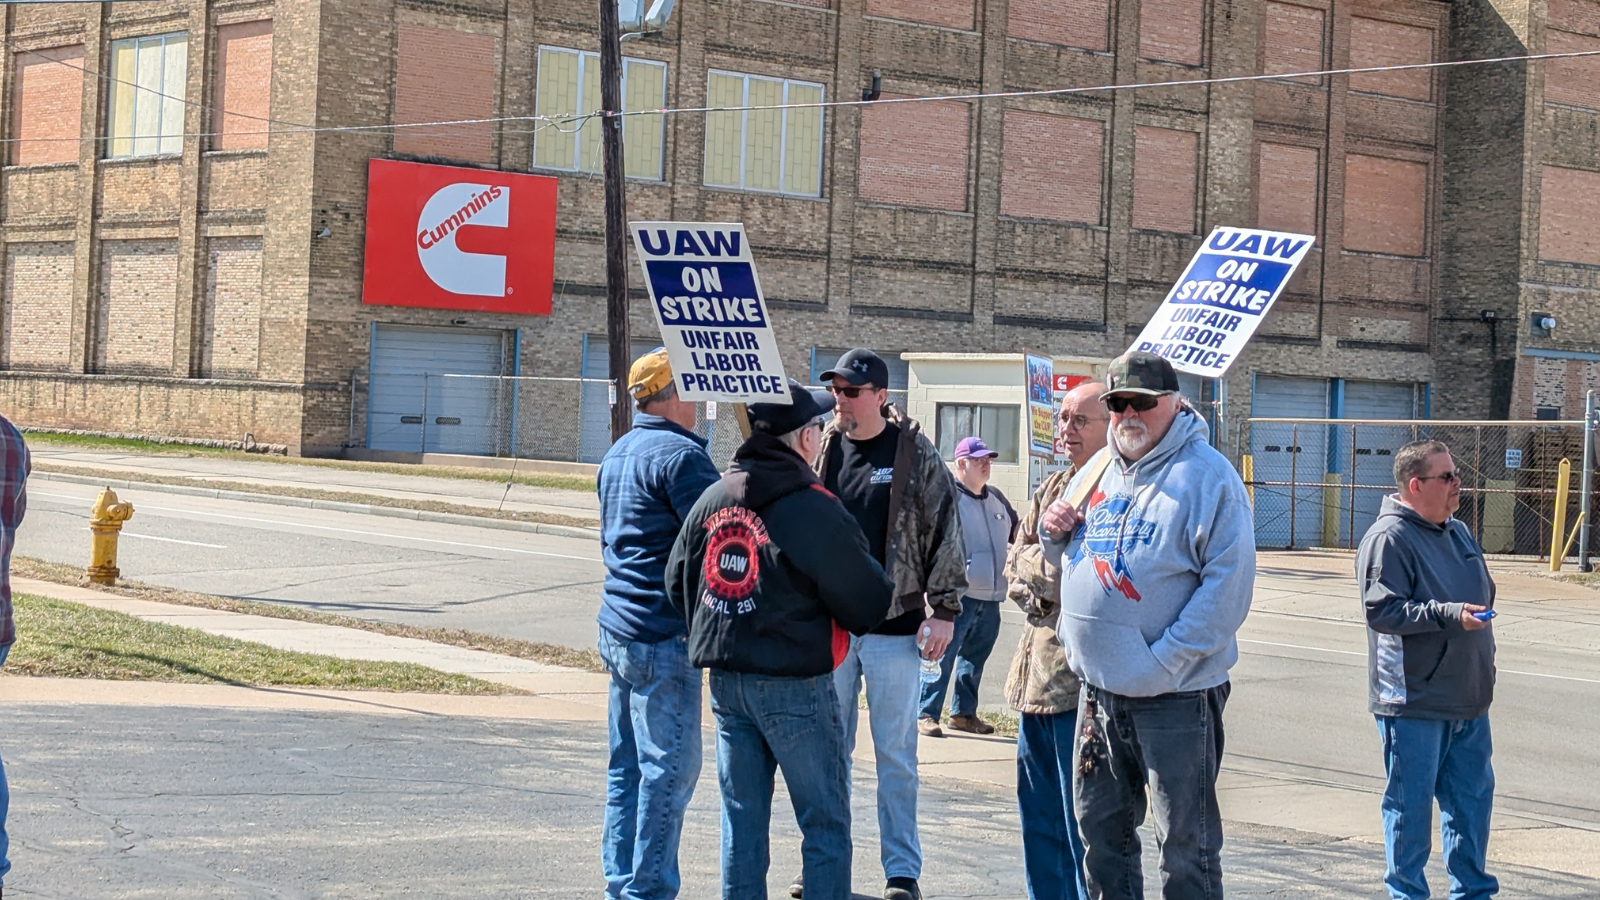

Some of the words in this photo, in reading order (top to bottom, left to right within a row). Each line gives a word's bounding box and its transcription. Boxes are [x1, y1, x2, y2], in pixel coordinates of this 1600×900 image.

[417, 185, 502, 250] Cummins
[638, 229, 741, 257] UAW
[1208, 231, 1308, 259] UAW
[681, 266, 723, 293] ON
[1215, 259, 1259, 282] ON
[1176, 280, 1271, 310] STRIKE
[660, 296, 762, 322] STRIKE
[1170, 307, 1243, 332] UNFAIR
[680, 329, 760, 350] UNFAIR
[1160, 325, 1227, 349] LABOR
[691, 351, 762, 372] LABOR
[1137, 341, 1231, 369] PRACTICE
[681, 373, 785, 395] PRACTICE
[702, 506, 771, 546] WISCONSIN
[1075, 521, 1152, 538] Wisconsnbly
[720, 553, 748, 573] UAW
[701, 588, 730, 614] LOCAL
[737, 597, 757, 615] 291
